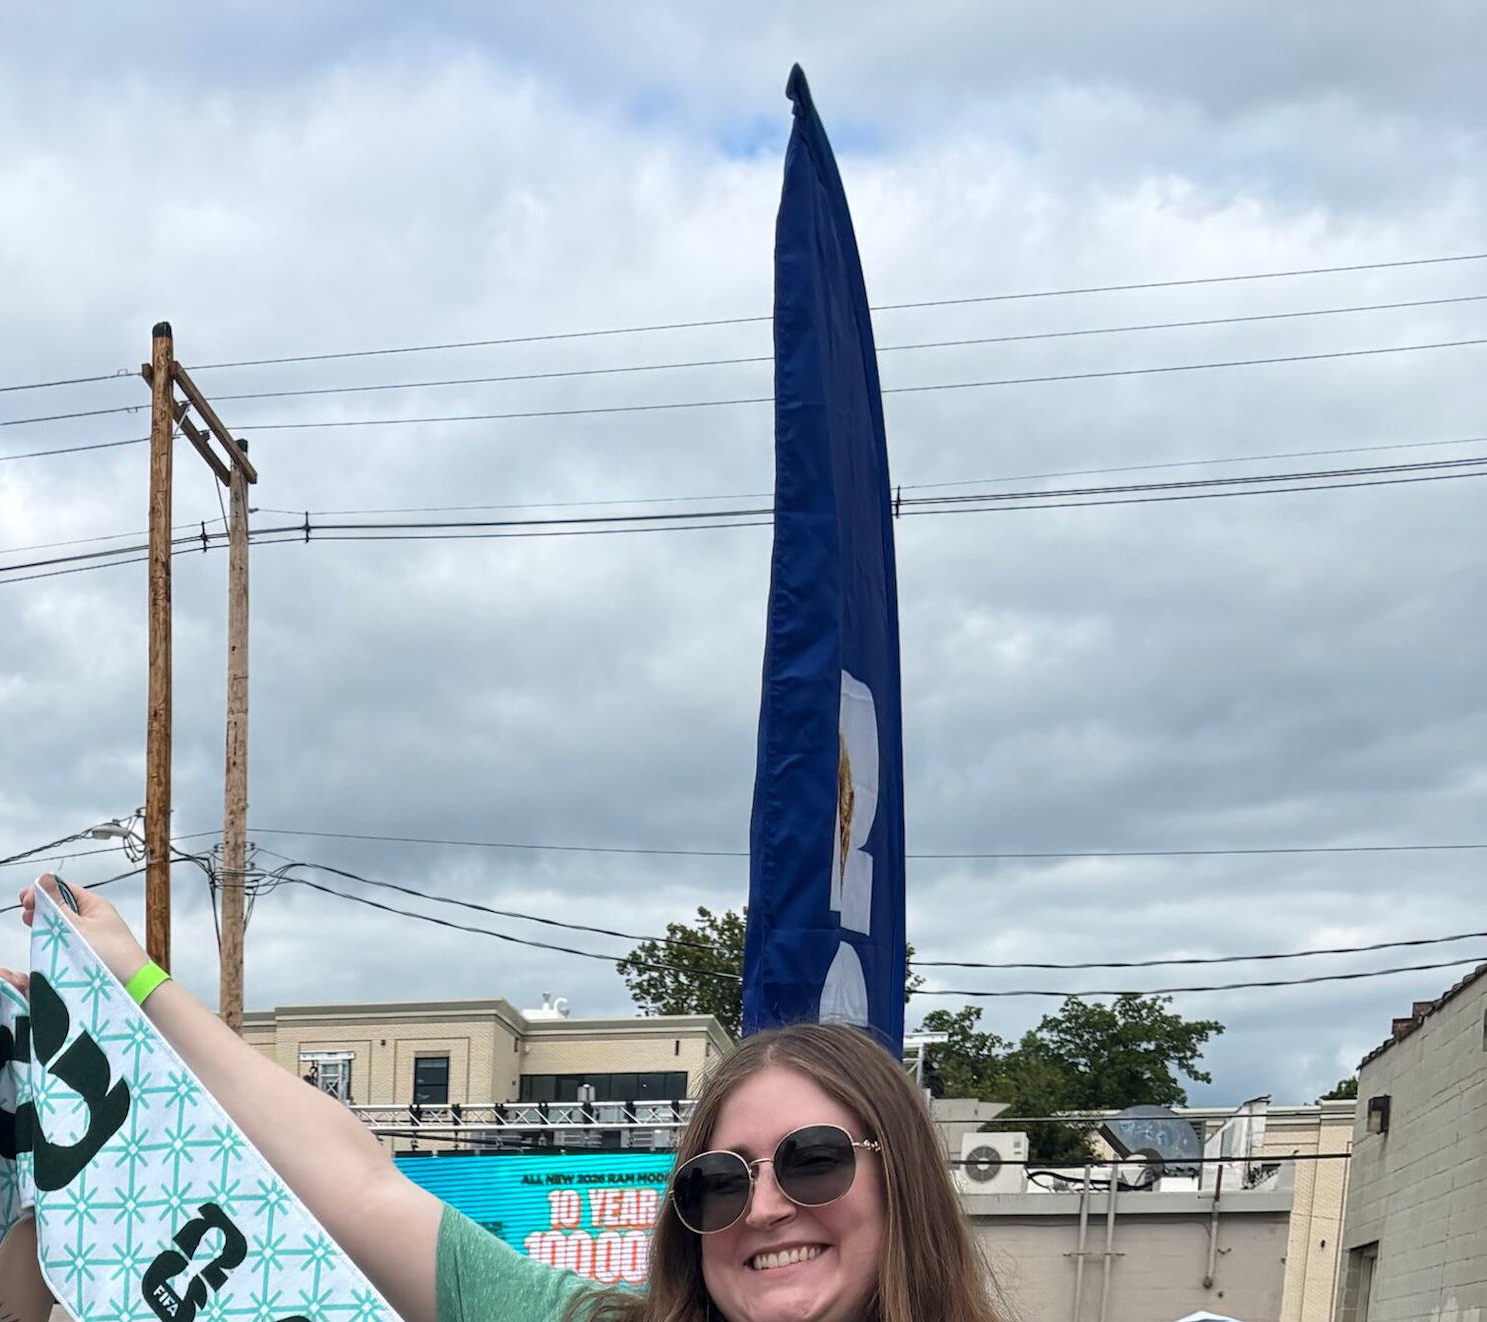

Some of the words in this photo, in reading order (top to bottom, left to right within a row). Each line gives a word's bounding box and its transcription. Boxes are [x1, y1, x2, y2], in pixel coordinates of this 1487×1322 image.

[521, 1174, 543, 1185] ALL
[545, 1174, 574, 1185] NEW
[608, 1173, 635, 1184] RAM
[547, 1188, 581, 1230] 10
[153, 1284, 180, 1318] FIFA
